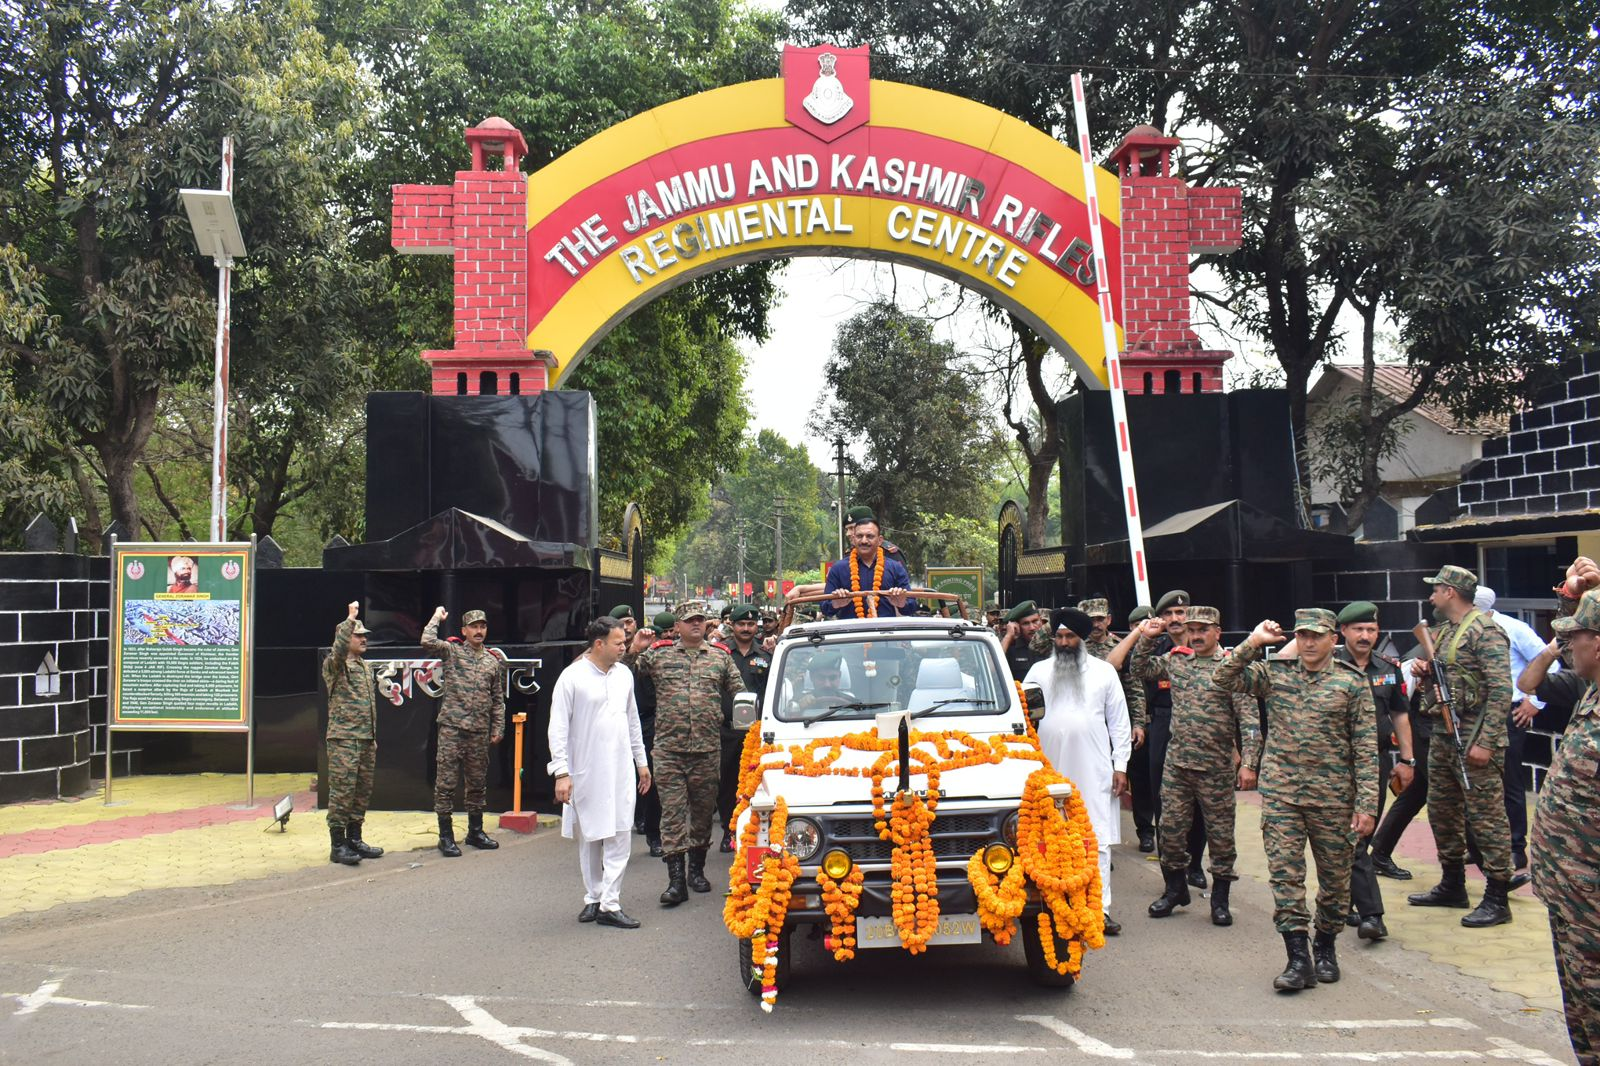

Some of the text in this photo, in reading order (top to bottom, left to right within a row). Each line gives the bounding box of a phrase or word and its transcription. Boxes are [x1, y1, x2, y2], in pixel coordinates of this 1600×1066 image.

[544, 153, 1098, 286] THE JAMMU AND KASHMIR RIFLES
[618, 198, 1029, 288] REGIMENTAL CENTRE
